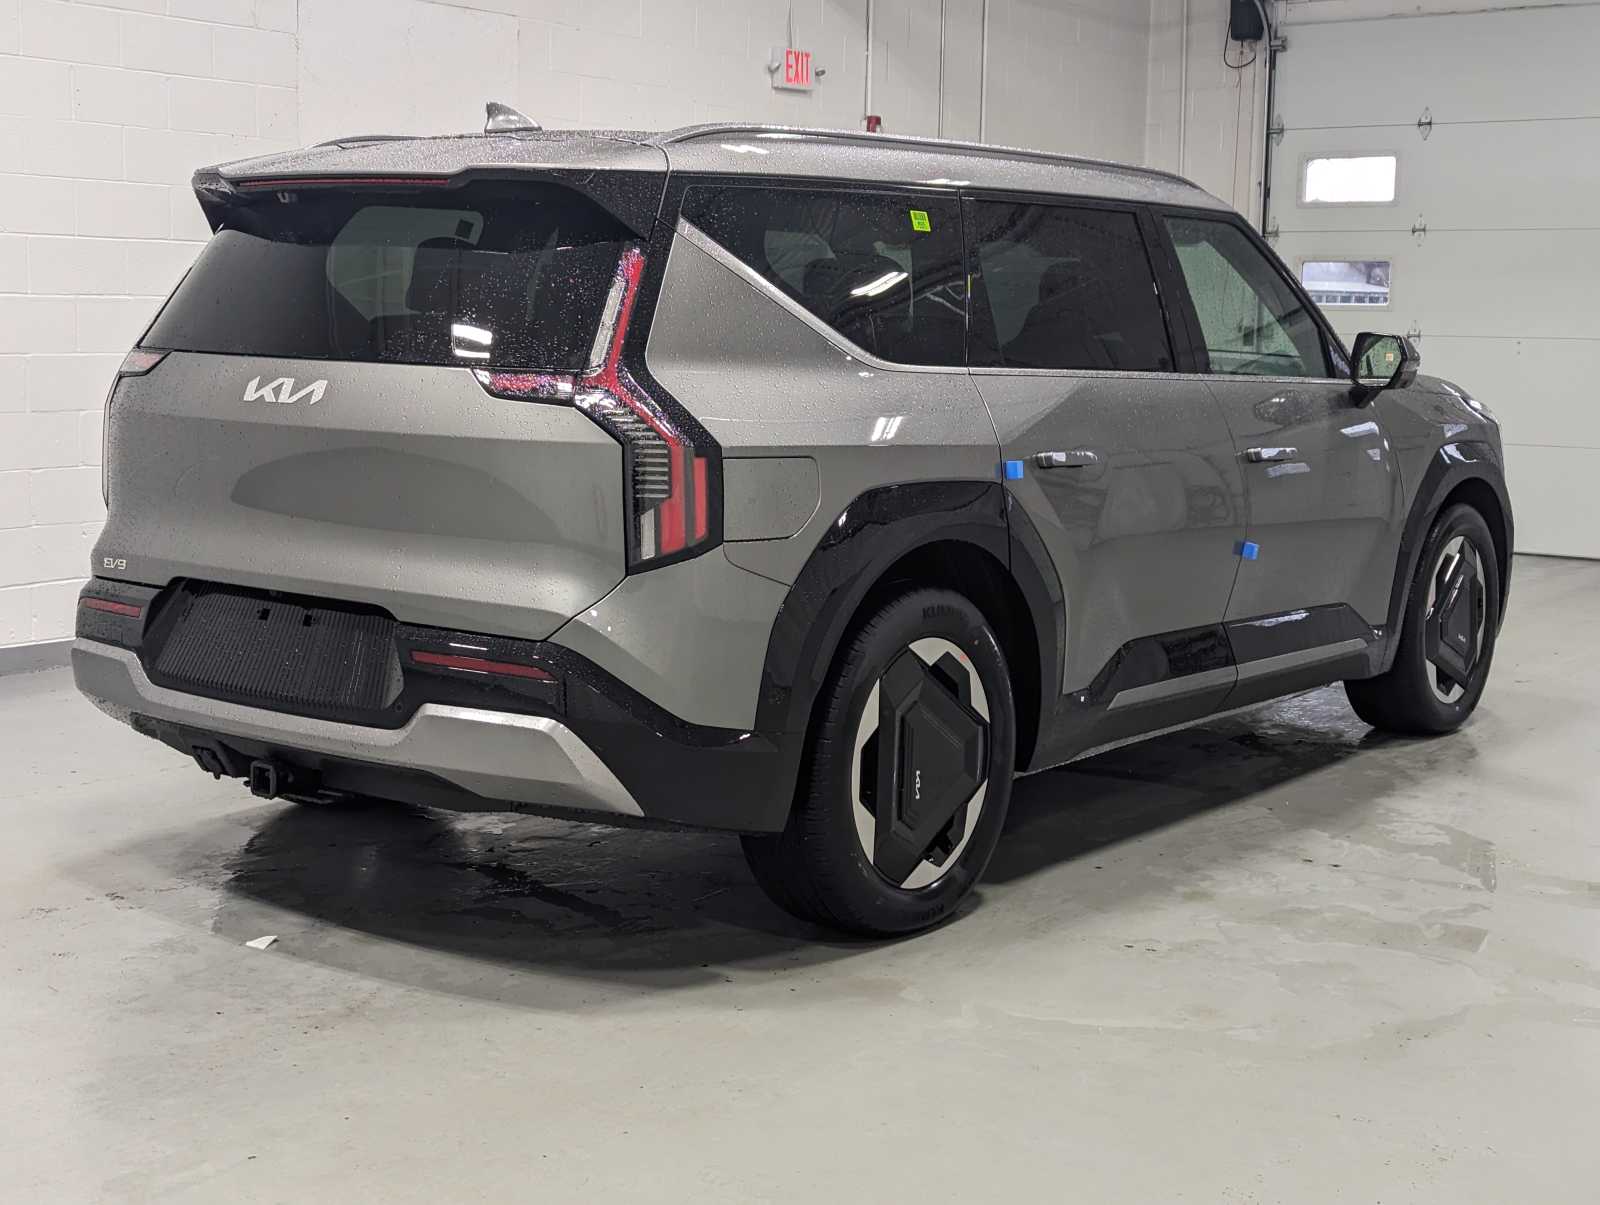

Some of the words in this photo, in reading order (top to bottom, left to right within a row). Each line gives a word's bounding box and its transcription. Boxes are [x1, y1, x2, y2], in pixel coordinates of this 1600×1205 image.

[785, 49, 811, 86] EXIT
[243, 375, 328, 405] KIA
[103, 557, 127, 570] EV9
